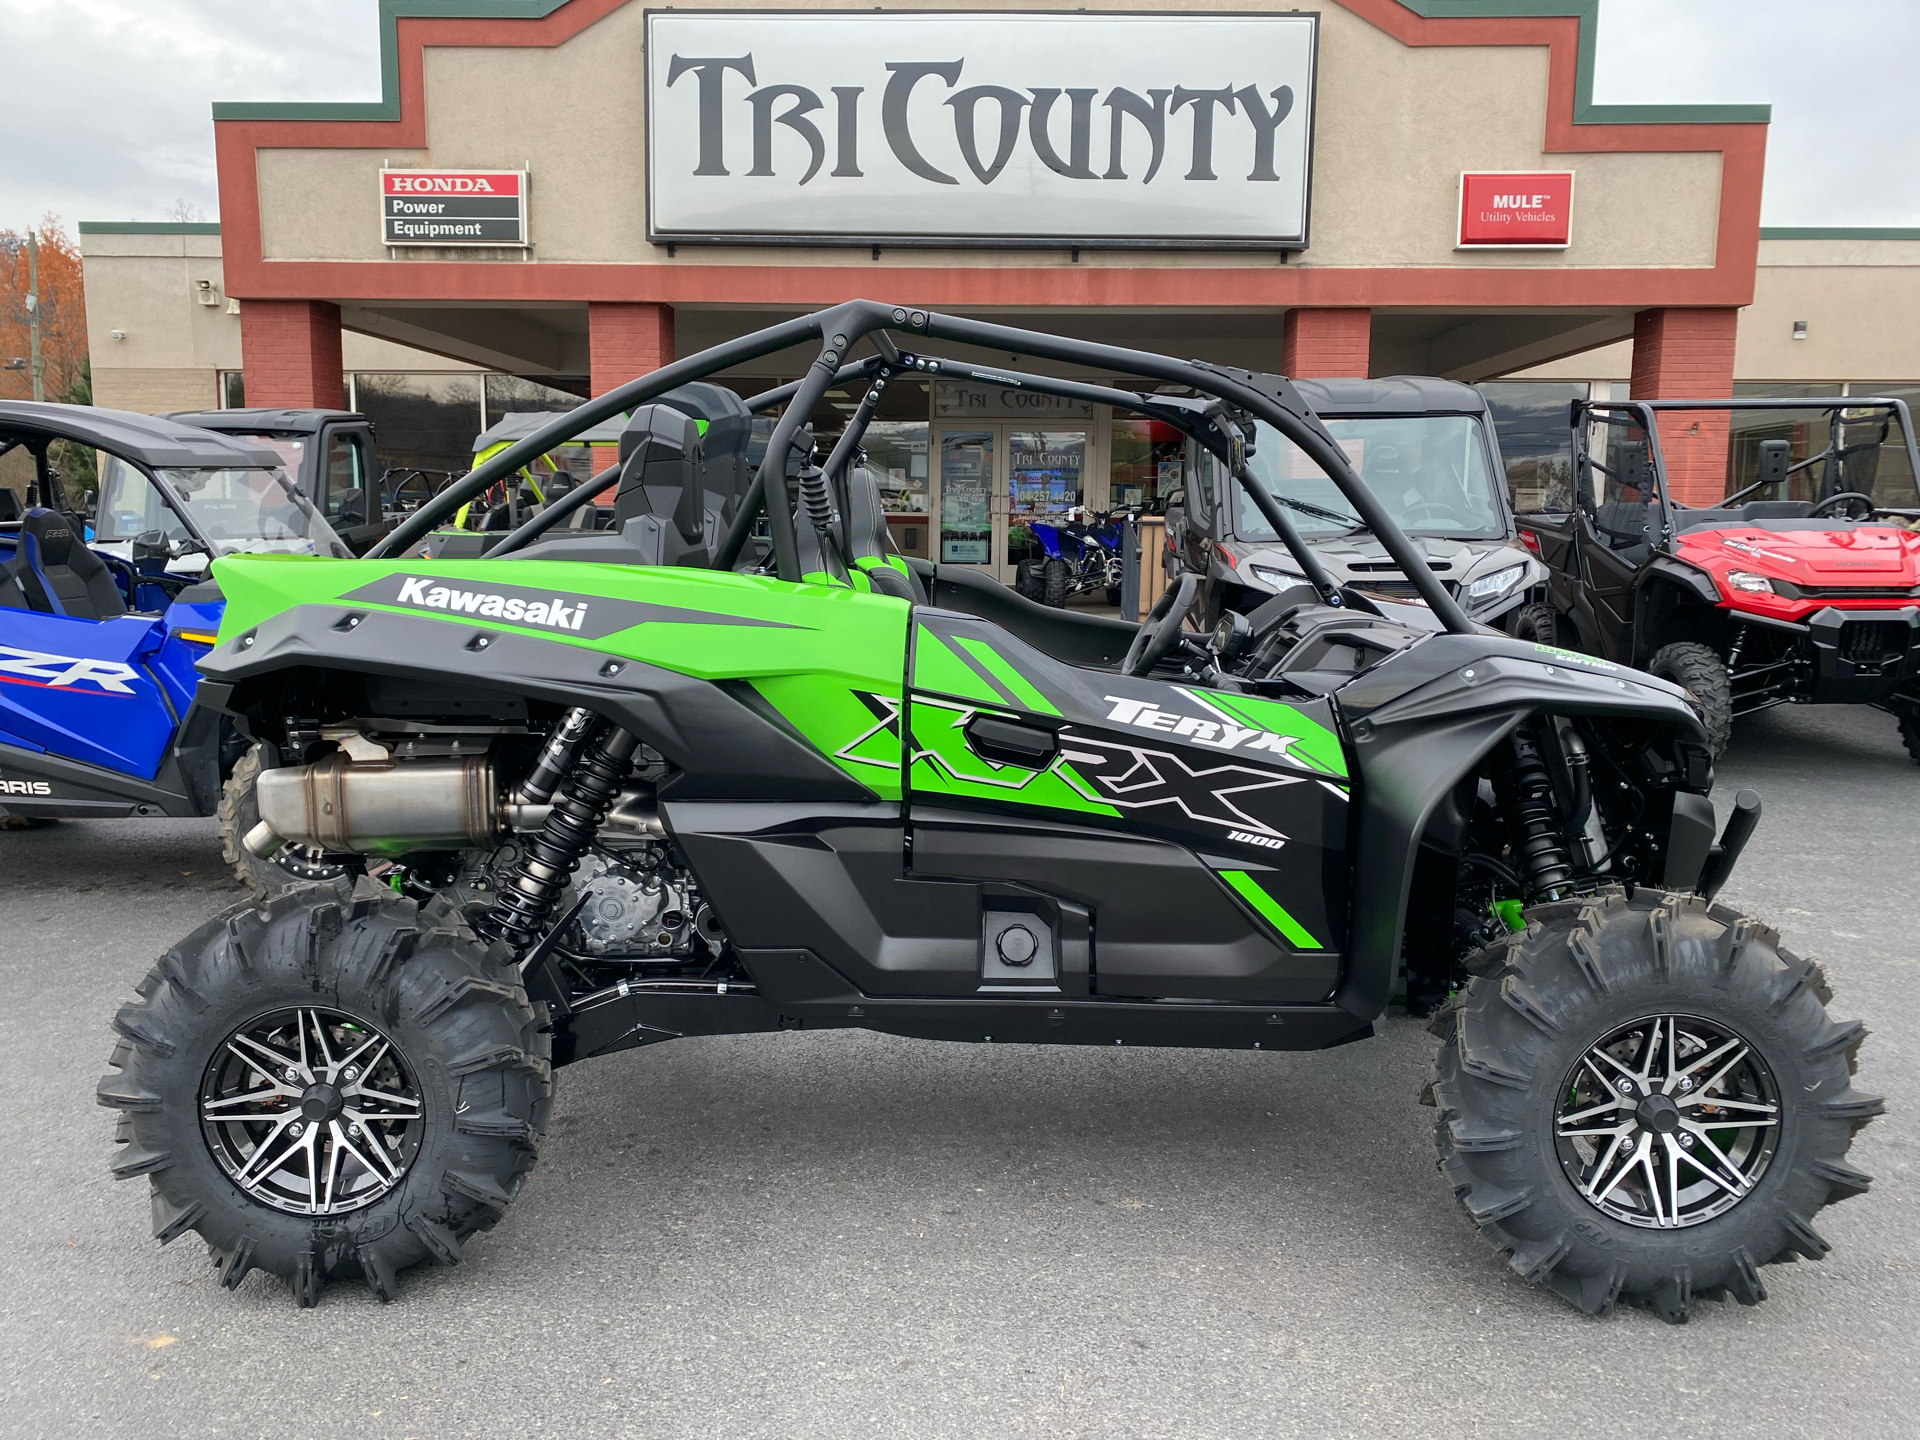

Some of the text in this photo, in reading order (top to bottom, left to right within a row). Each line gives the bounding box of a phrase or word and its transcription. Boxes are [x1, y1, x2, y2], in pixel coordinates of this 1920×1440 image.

[666, 52, 1294, 186] TRI COUNTY
[392, 178, 494, 192] HONDA
[393, 200, 445, 213] Power
[1480, 211, 1556, 224] Utility Vehicles
[394, 221, 482, 237] Equipment
[954, 389, 986, 408] TRI
[1015, 452, 1080, 465] TRI COUNTY
[45, 529, 69, 539] RZR
[397, 577, 588, 630] Kawasaki
[1226, 830, 1286, 849] 1000
[1574, 1223, 1613, 1246] ITP
